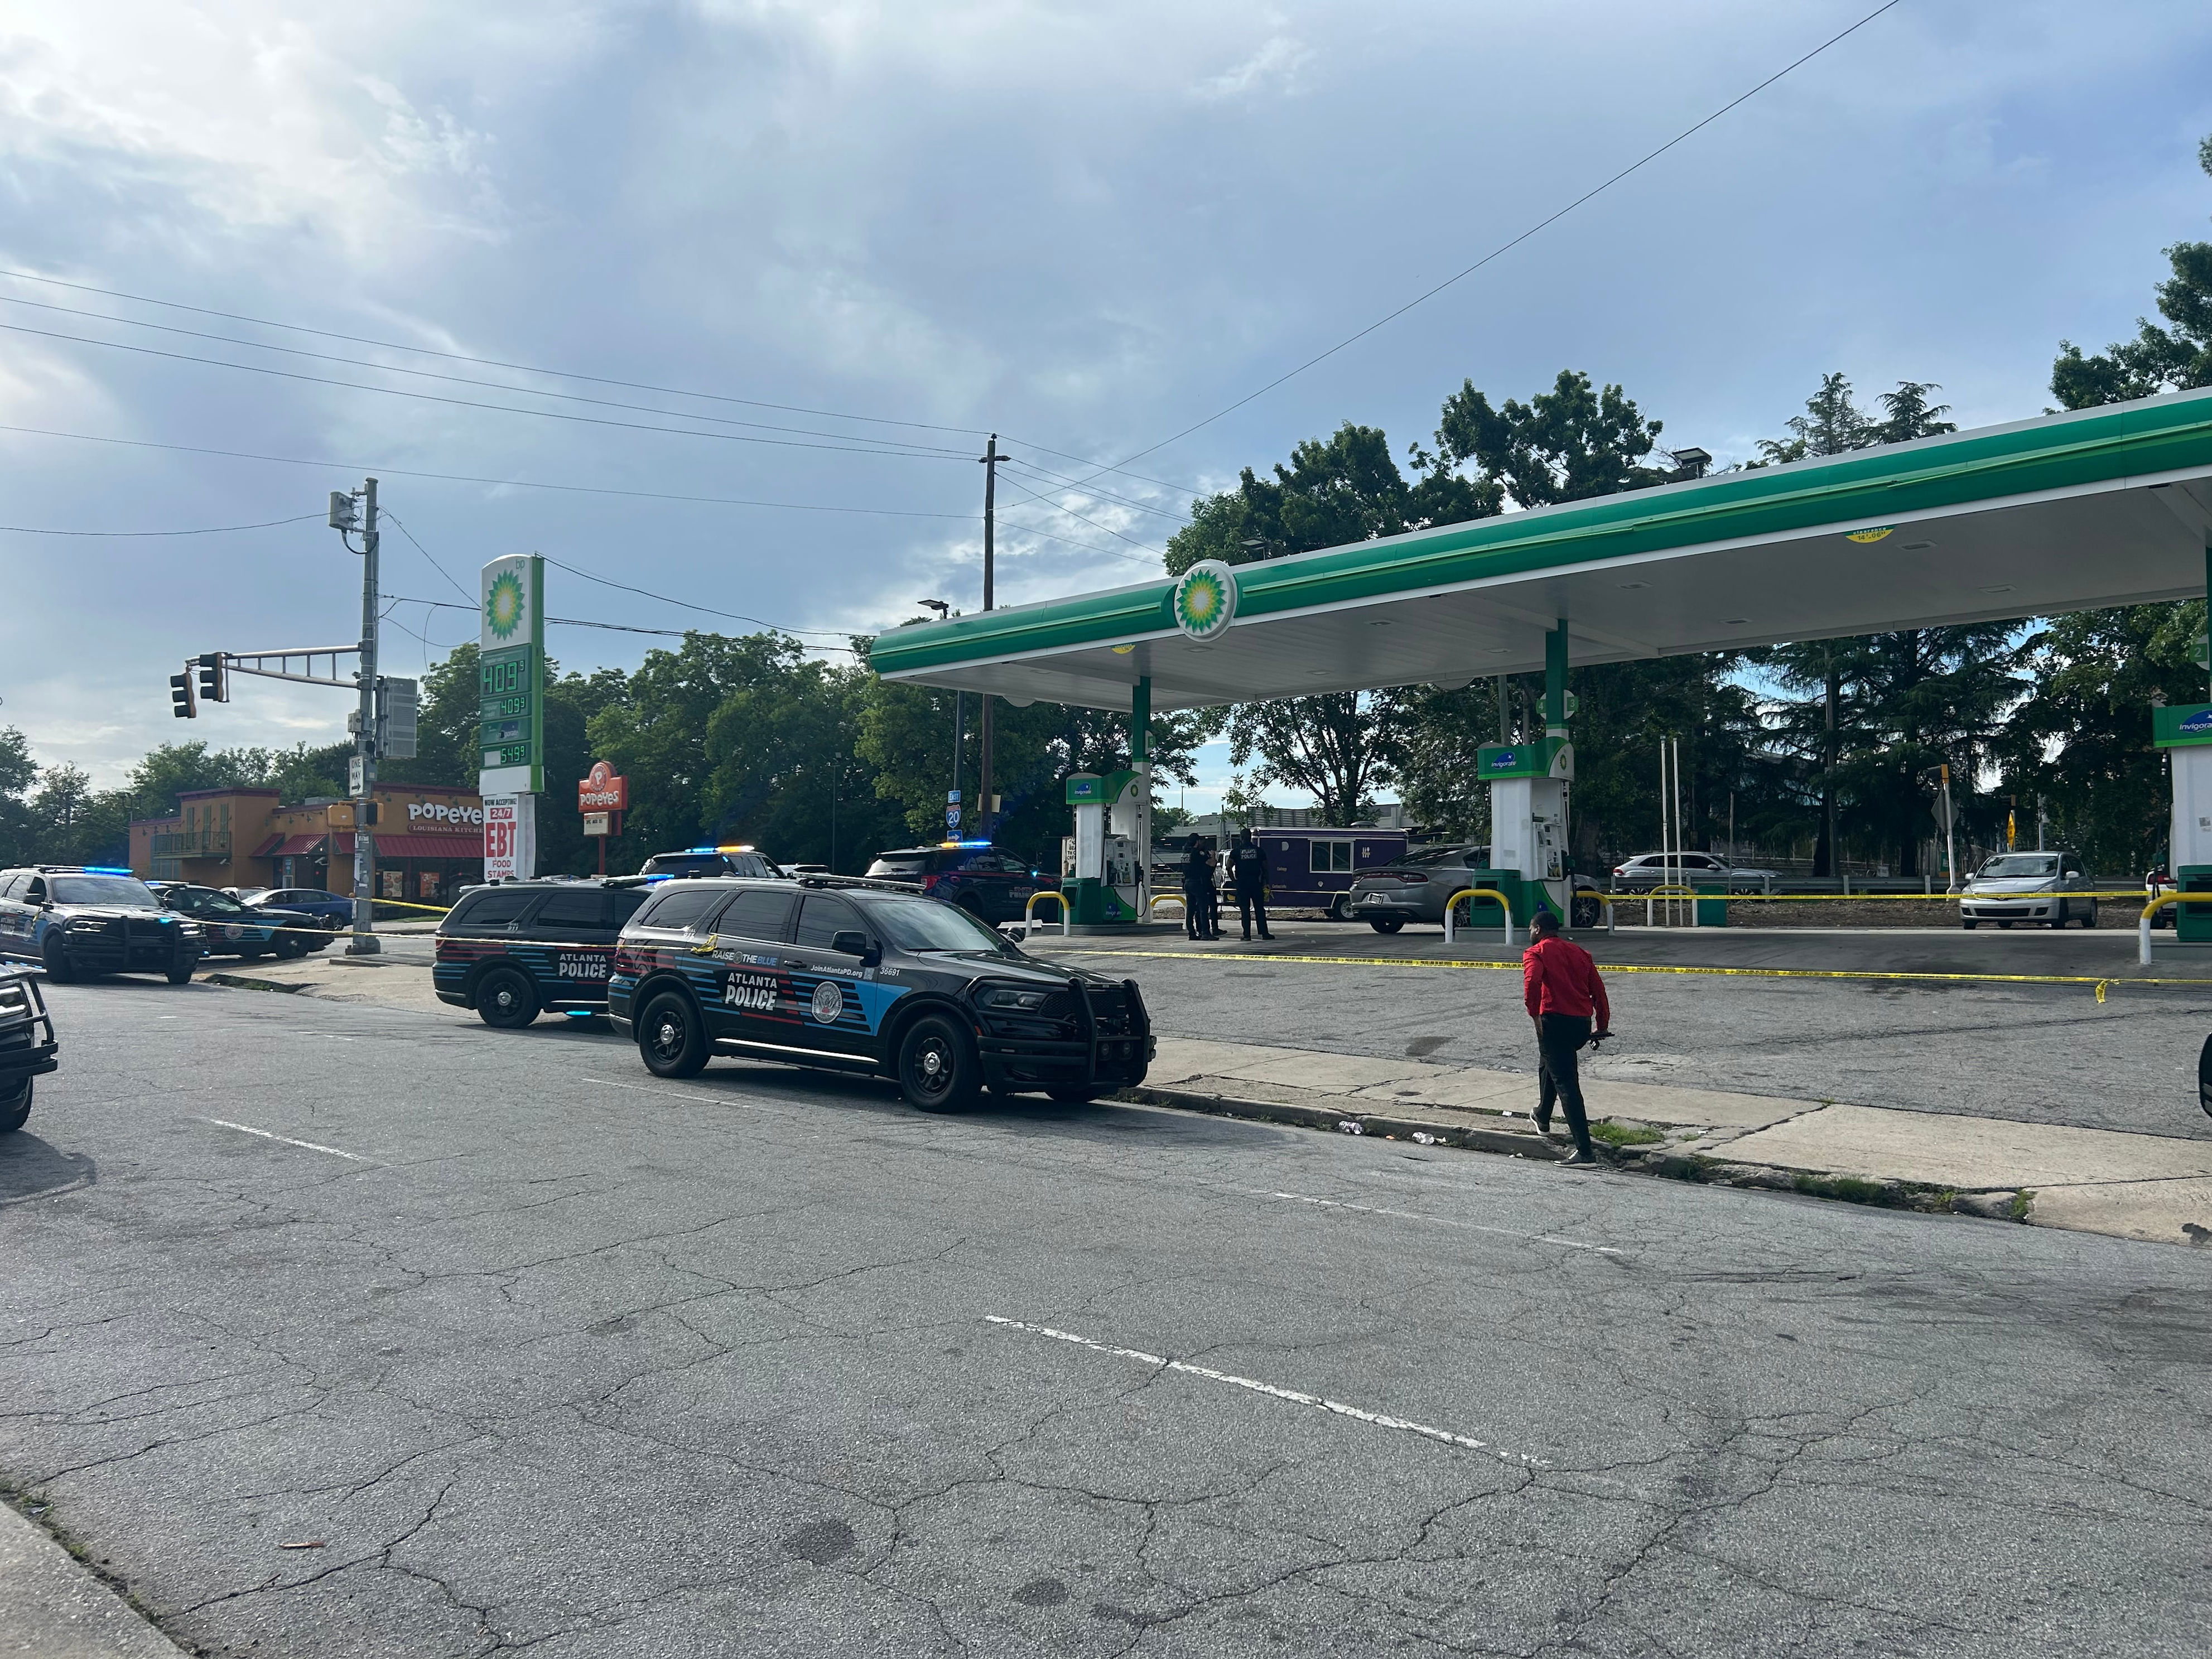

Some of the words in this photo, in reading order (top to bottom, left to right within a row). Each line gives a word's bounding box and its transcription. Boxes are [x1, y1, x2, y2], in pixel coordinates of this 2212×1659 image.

[515, 560, 525, 571] bp
[1539, 702, 1544, 710] 4
[1570, 699, 1575, 707] 3
[2179, 722, 2212, 731] Invigora
[351, 759, 361, 769] ONE
[351, 771, 361, 780] WAY
[949, 793, 959, 801] EAST
[408, 803, 483, 824] POPeYe
[492, 808, 512, 818] 24/7
[948, 811, 959, 824] 20
[485, 822, 517, 857] EBT
[559, 953, 606, 962] ATLANTA
[712, 950, 735, 961] RAISE
[559, 962, 606, 978] POLICE
[811, 964, 863, 978] JoinAtlantaPD.org
[880, 967, 900, 976] 36691
[727, 972, 777, 988] ATLANTA
[725, 985, 777, 1011] POLICE
